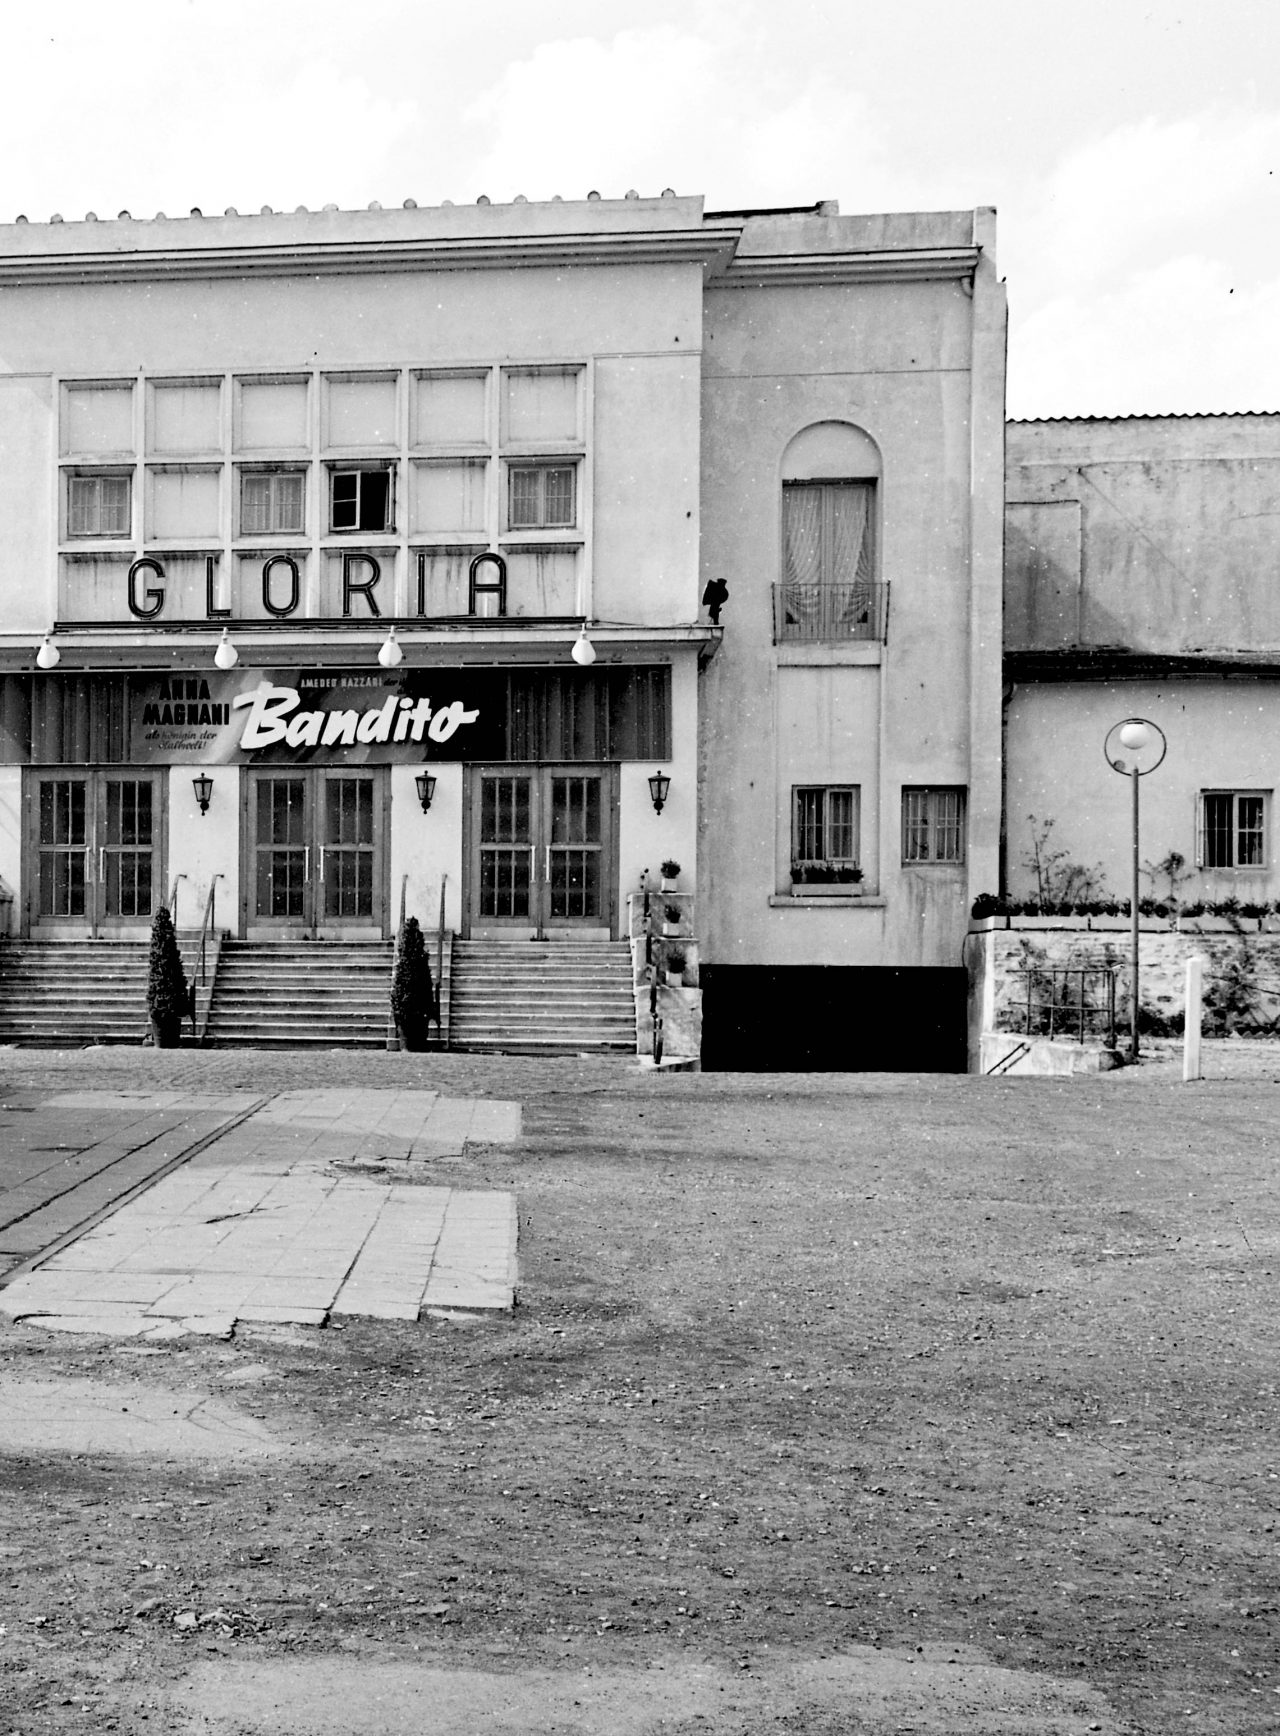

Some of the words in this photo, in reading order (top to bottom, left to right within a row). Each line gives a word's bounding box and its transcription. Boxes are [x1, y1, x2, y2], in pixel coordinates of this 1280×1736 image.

[127, 552, 507, 620] GLORIA
[159, 679, 211, 700] ANNA
[300, 678, 338, 688] AMEDEO
[142, 703, 230, 725] MAGNANI
[233, 681, 480, 750] Bandito
